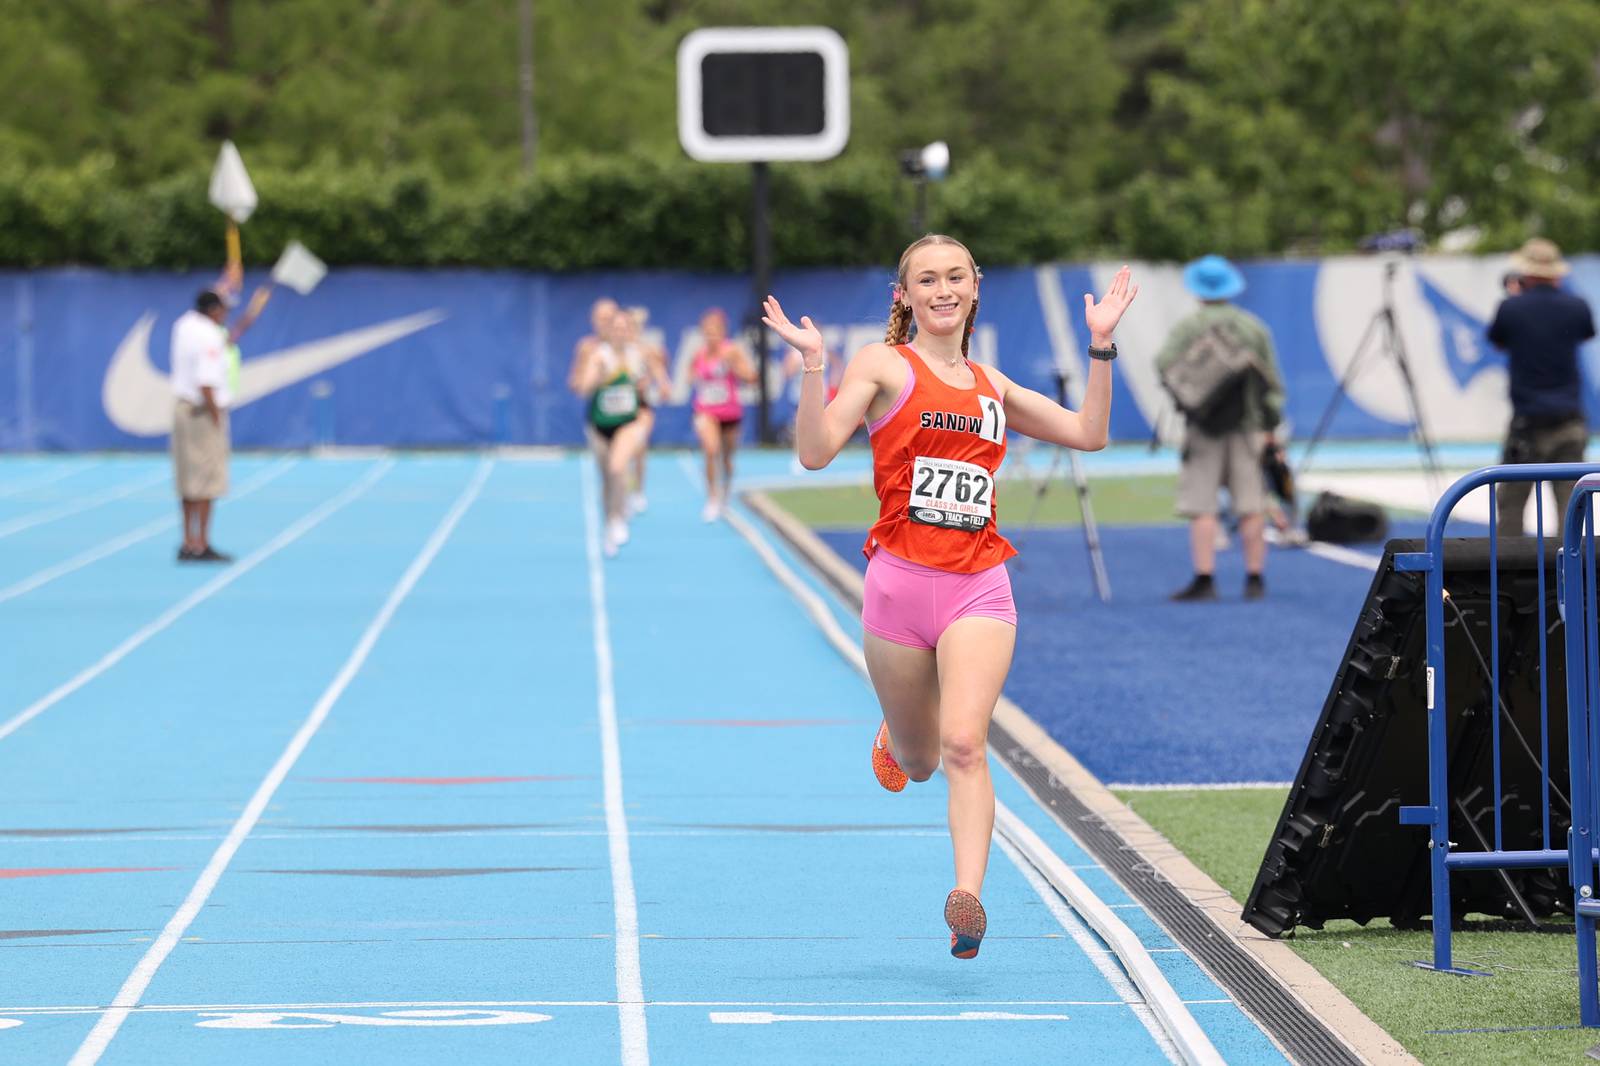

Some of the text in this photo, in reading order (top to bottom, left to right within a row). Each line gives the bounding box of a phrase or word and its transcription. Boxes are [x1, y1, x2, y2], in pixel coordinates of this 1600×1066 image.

[988, 401, 999, 440] 1
[915, 466, 988, 506] 2762
[925, 499, 979, 514] CLASS 2A GIRLS
[944, 512, 963, 522] TRACK
[970, 515, 985, 526] FIELD
